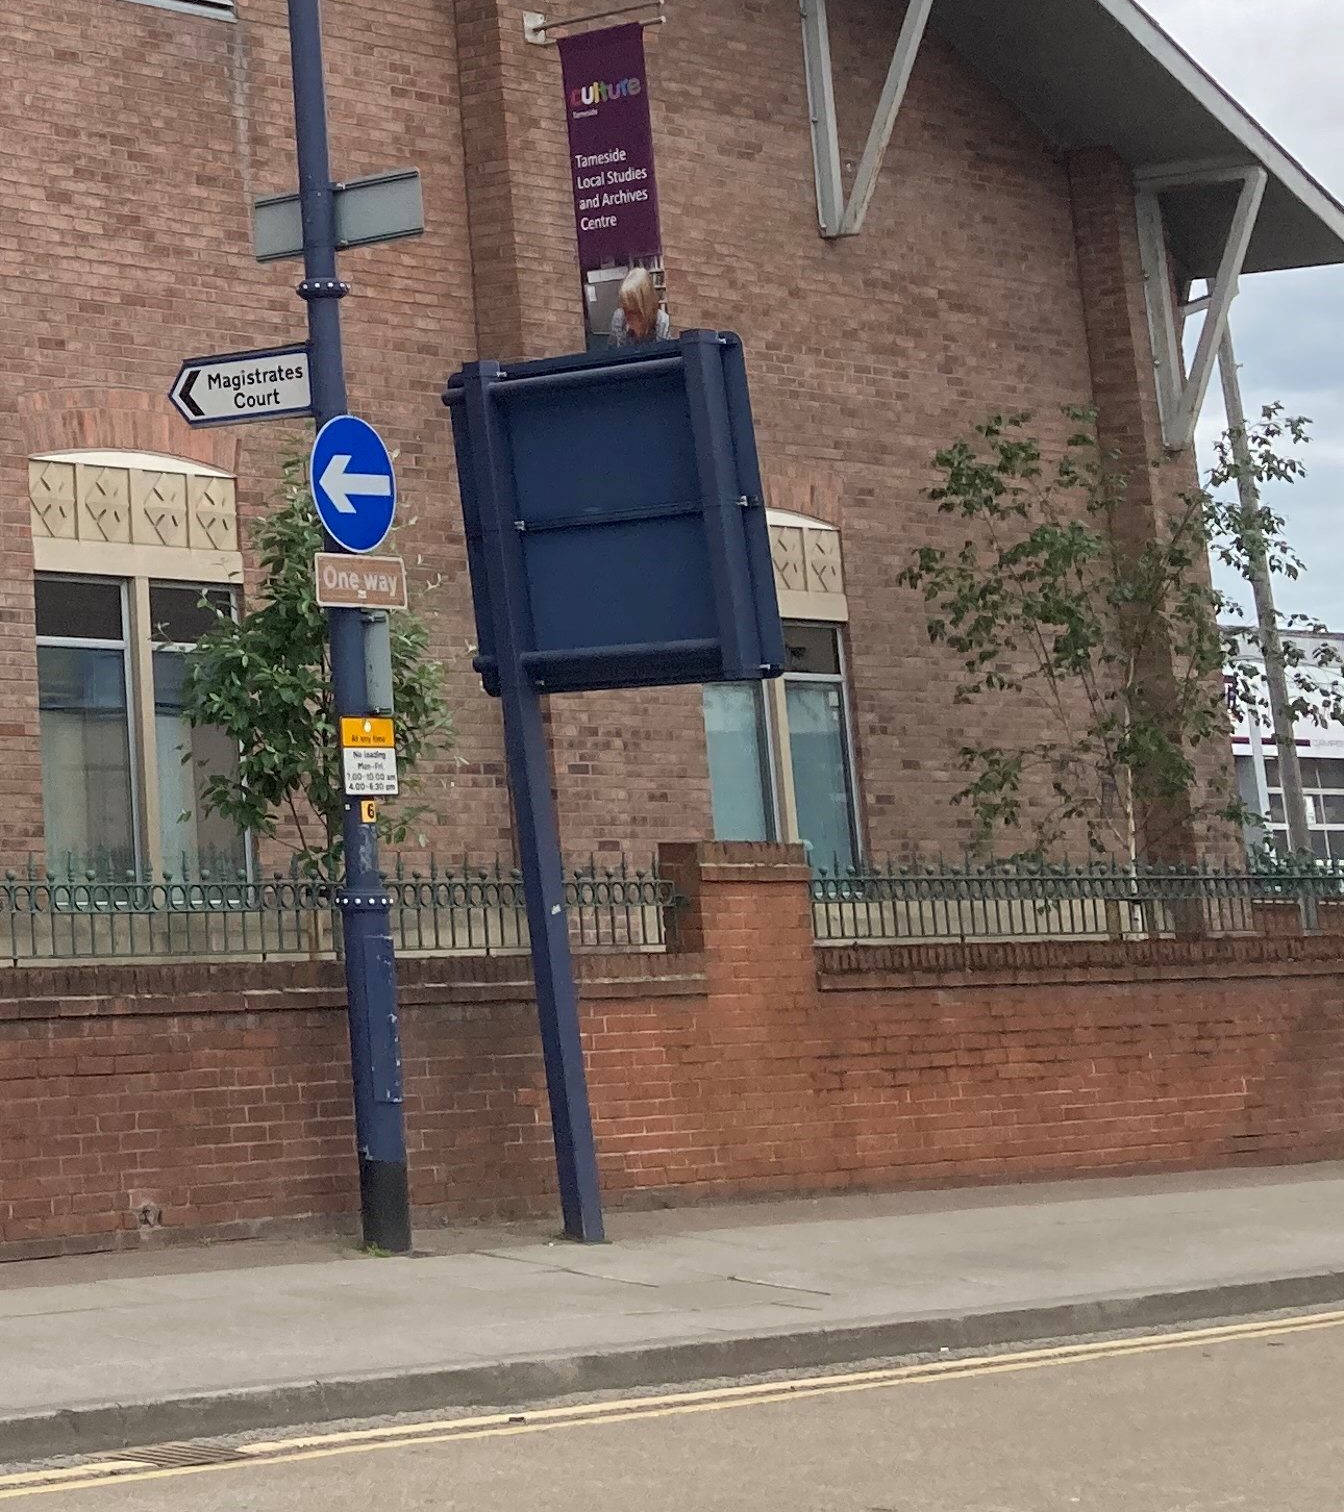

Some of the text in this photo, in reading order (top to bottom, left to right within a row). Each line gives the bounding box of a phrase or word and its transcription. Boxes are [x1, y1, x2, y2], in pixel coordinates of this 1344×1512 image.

[570, 77, 642, 106] culture
[575, 148, 627, 168] Tameside
[577, 167, 648, 189] Local Studies
[579, 189, 648, 210] and Archives
[581, 215, 617, 231] Centre
[207, 365, 303, 391] Magistrates
[234, 388, 281, 408] Court
[323, 565, 398, 597] One way
[367, 803, 375, 819] 6
